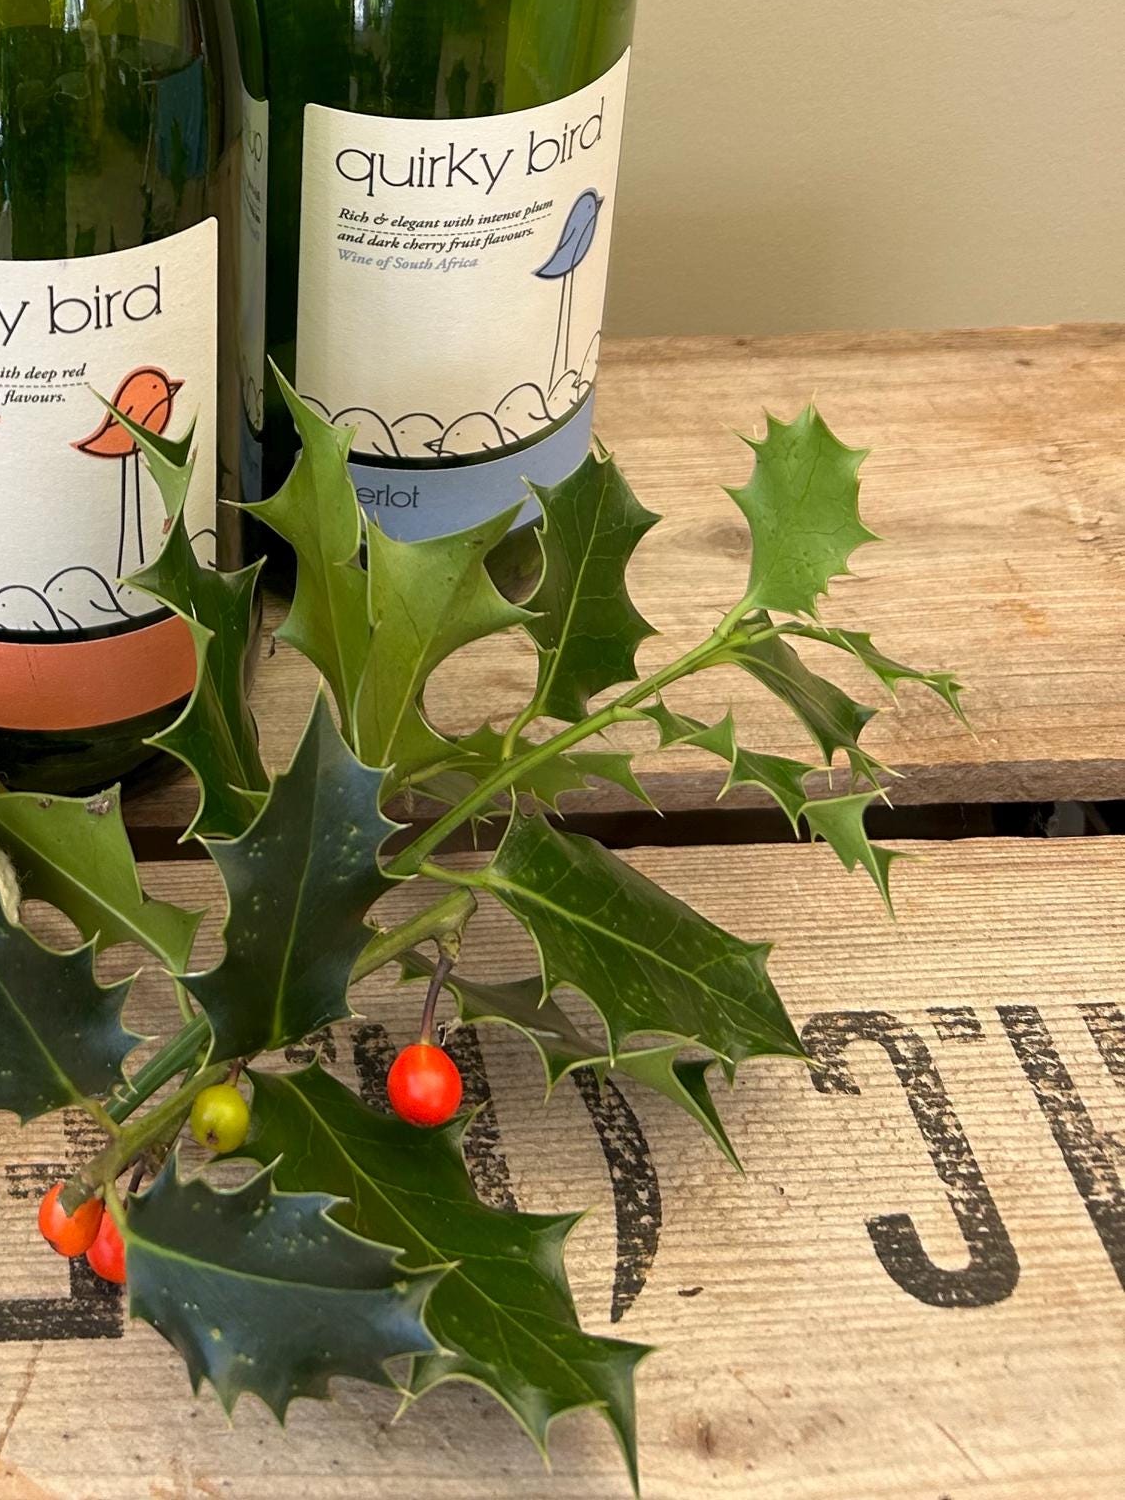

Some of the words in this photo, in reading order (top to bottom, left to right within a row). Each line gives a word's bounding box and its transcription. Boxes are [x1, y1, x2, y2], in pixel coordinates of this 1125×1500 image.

[336, 142, 514, 197] quirky
[526, 96, 605, 176] bird
[338, 208, 369, 224] Rich
[373, 212, 388, 225] &
[390, 214, 440, 231] elegant
[443, 214, 475, 229] with
[478, 209, 522, 226] intense
[524, 199, 554, 220] plum
[336, 231, 364, 245] and
[366, 234, 400, 249] dark
[402, 238, 445, 253] cherry
[445, 237, 481, 253] fruit
[480, 228, 534, 250] flavours.
[338, 248, 372, 265] Wine
[375, 256, 393, 270] of
[393, 257, 433, 271] South
[435, 256, 479, 273] Africa
[47, 265, 163, 335] bird
[24, 366, 58, 383] deep
[62, 363, 87, 378] red
[1, 389, 66, 406] flavours.
[356, 483, 420, 509] erlot
